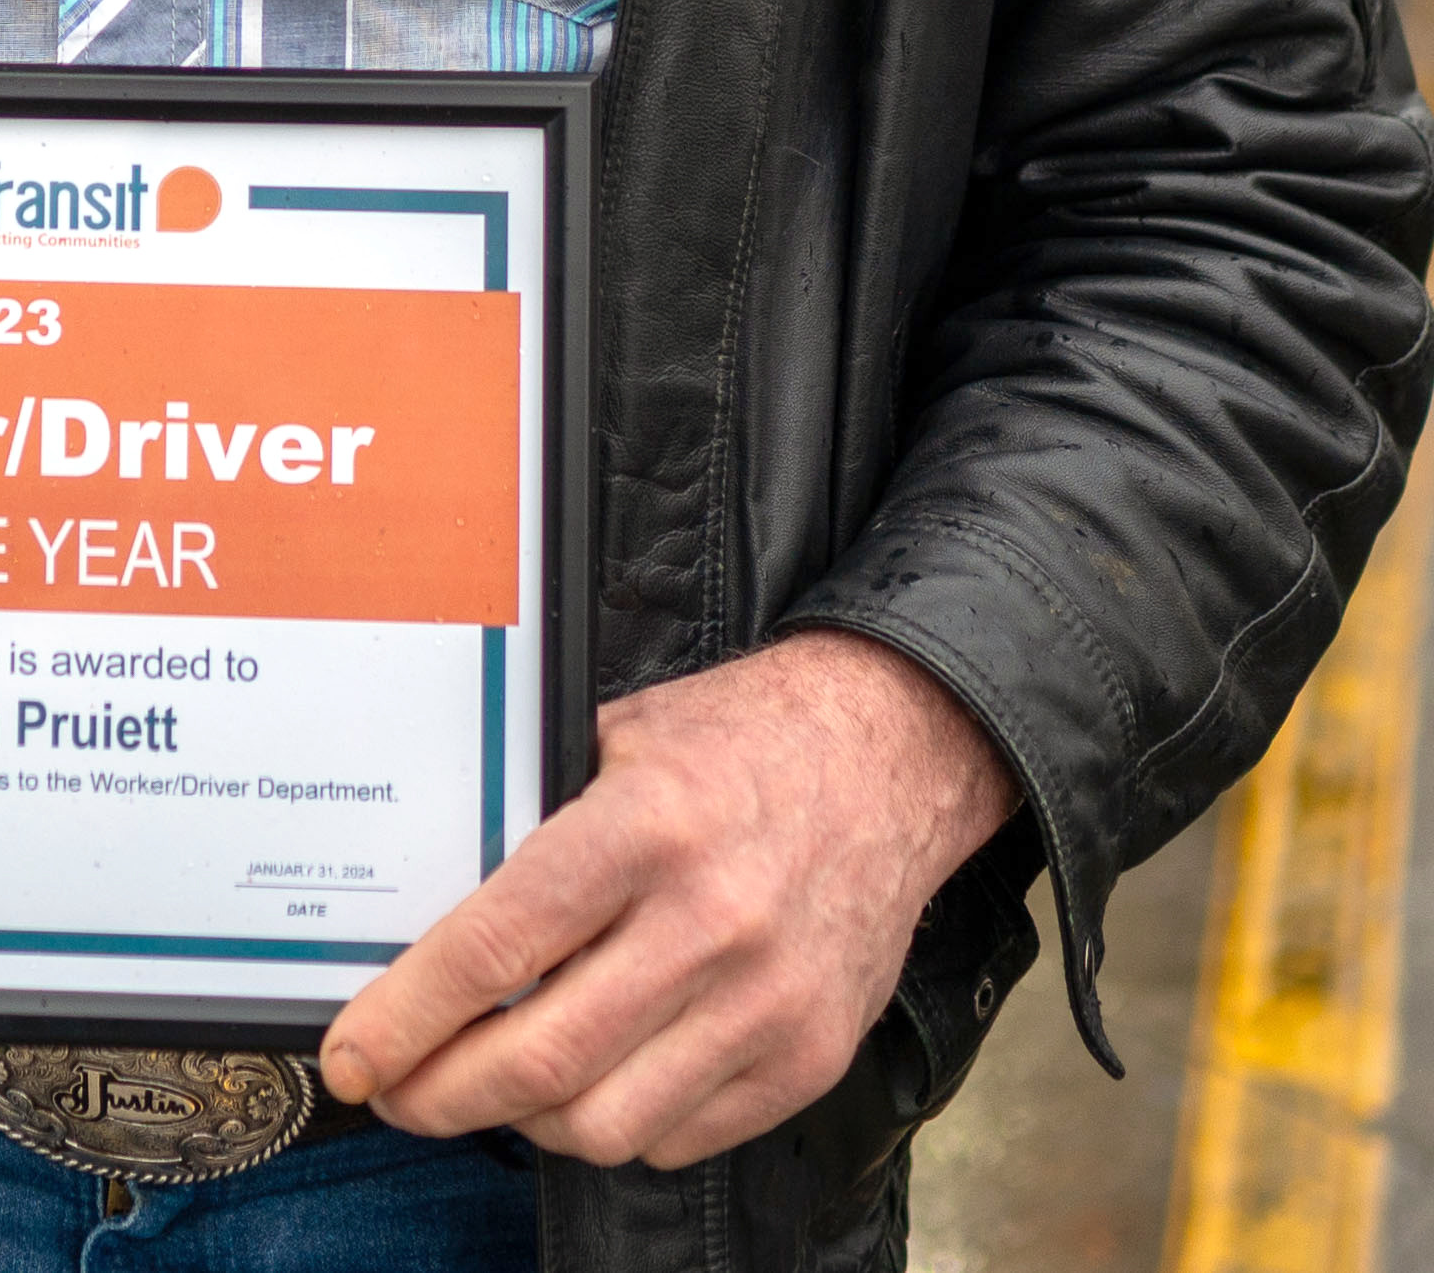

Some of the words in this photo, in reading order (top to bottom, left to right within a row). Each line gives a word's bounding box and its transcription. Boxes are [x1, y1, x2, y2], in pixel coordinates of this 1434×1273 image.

[38, 233, 140, 249] Communities
[27, 517, 219, 589] YEAR
[9, 642, 37, 675] is
[50, 645, 211, 681] awarded
[225, 651, 259, 682] to
[16, 699, 178, 752] Pruiett
[18, 770, 39, 791] to
[47, 771, 81, 793] the
[90, 772, 250, 798] Worker/Driver
[258, 775, 399, 804] Department.
[246, 861, 313, 877] JANUARY
[342, 864, 374, 879] 2024
[287, 903, 327, 917] DATE
[56, 1066, 189, 1121] Justin
